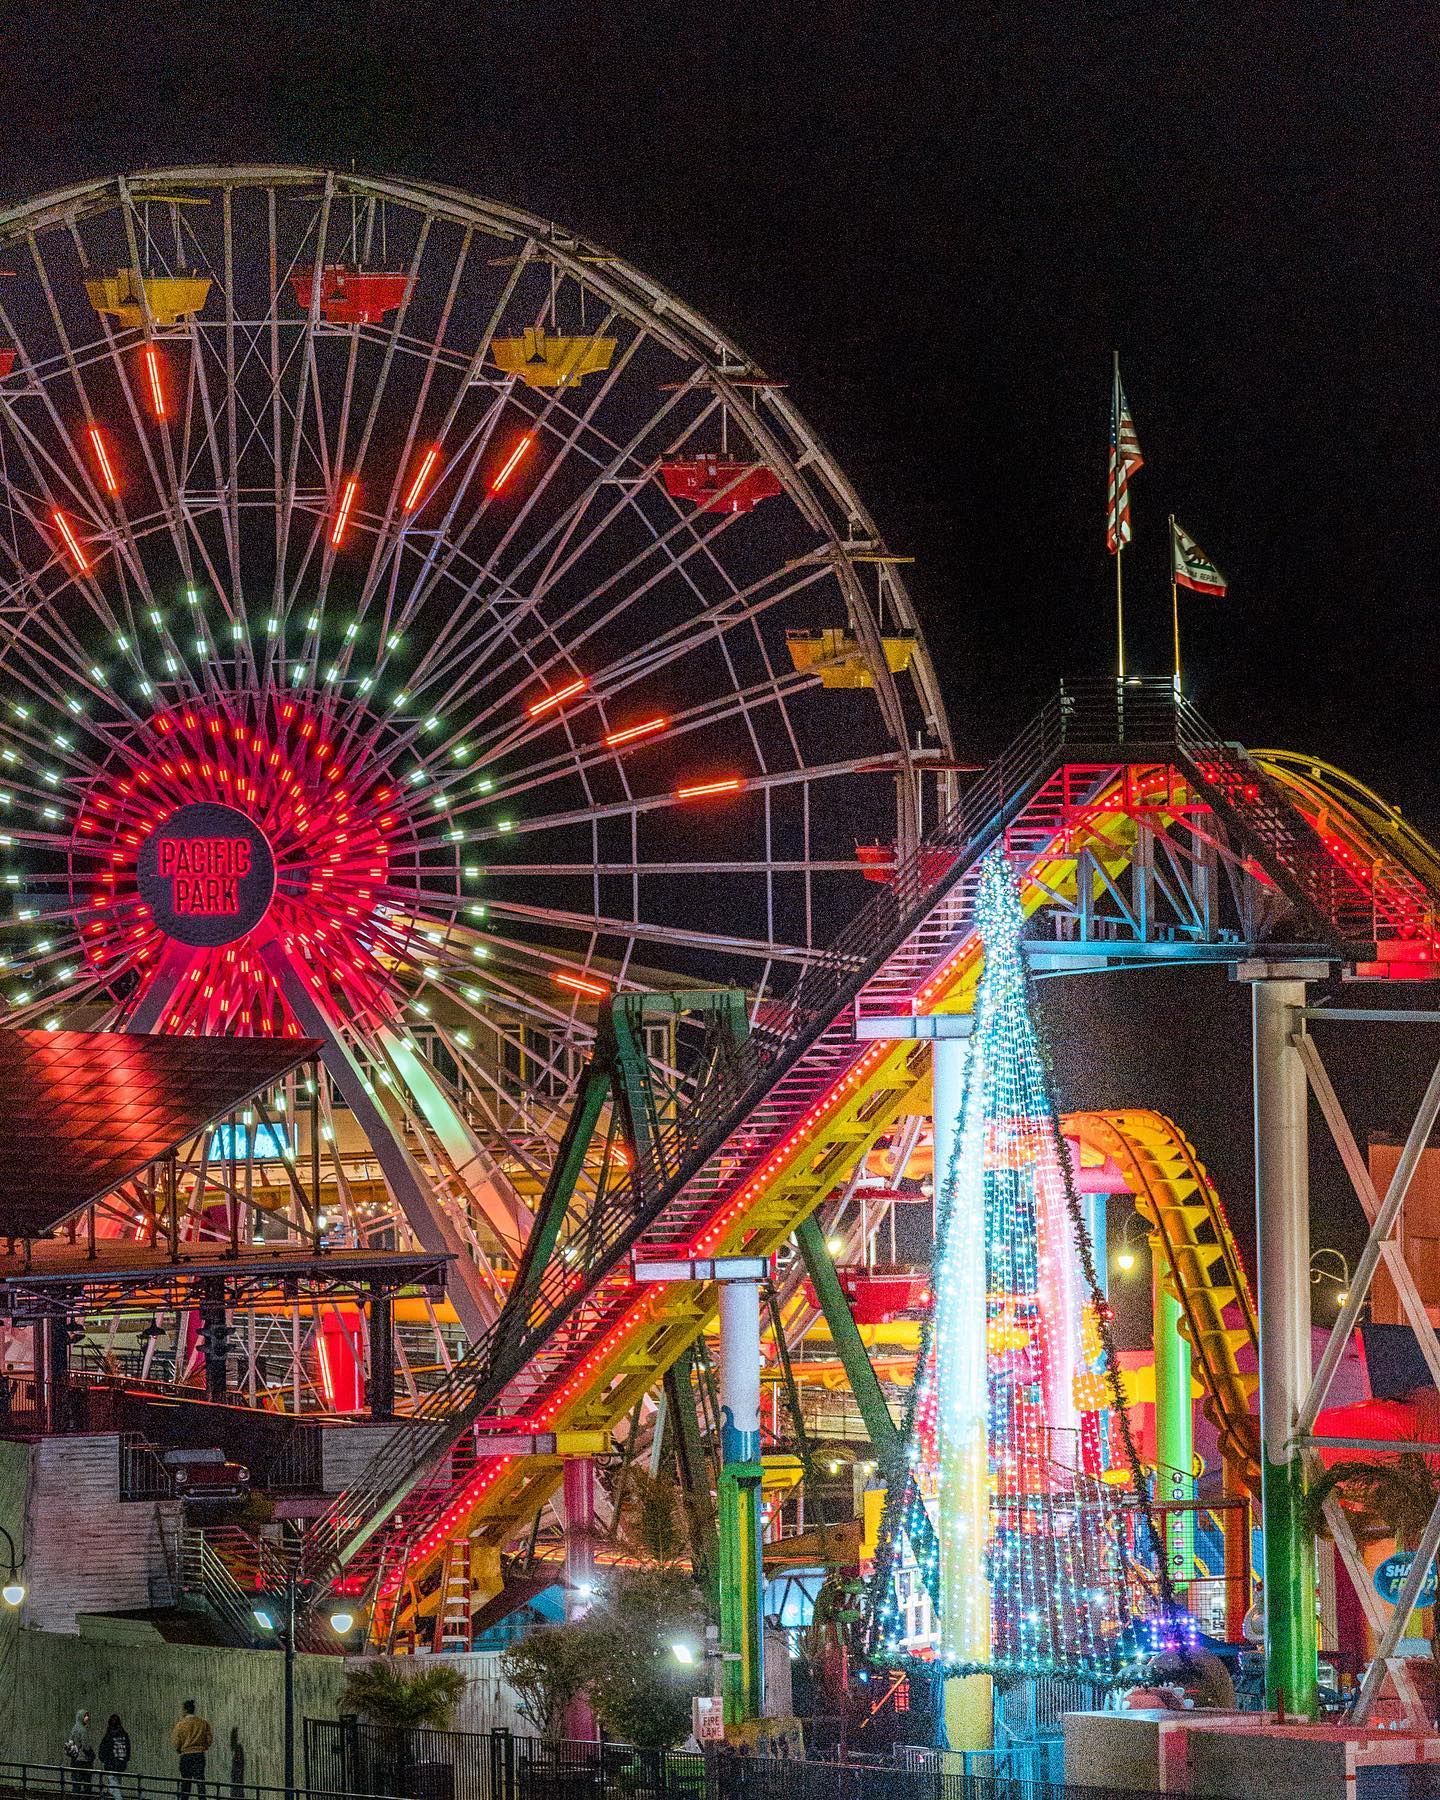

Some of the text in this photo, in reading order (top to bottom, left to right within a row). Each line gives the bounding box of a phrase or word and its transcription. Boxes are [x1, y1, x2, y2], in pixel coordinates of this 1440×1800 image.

[159, 839, 250, 876] PACIFIC
[174, 878, 237, 914] PARK
[702, 1727, 722, 1738] LANE
[703, 1716, 720, 1726] FIRE
